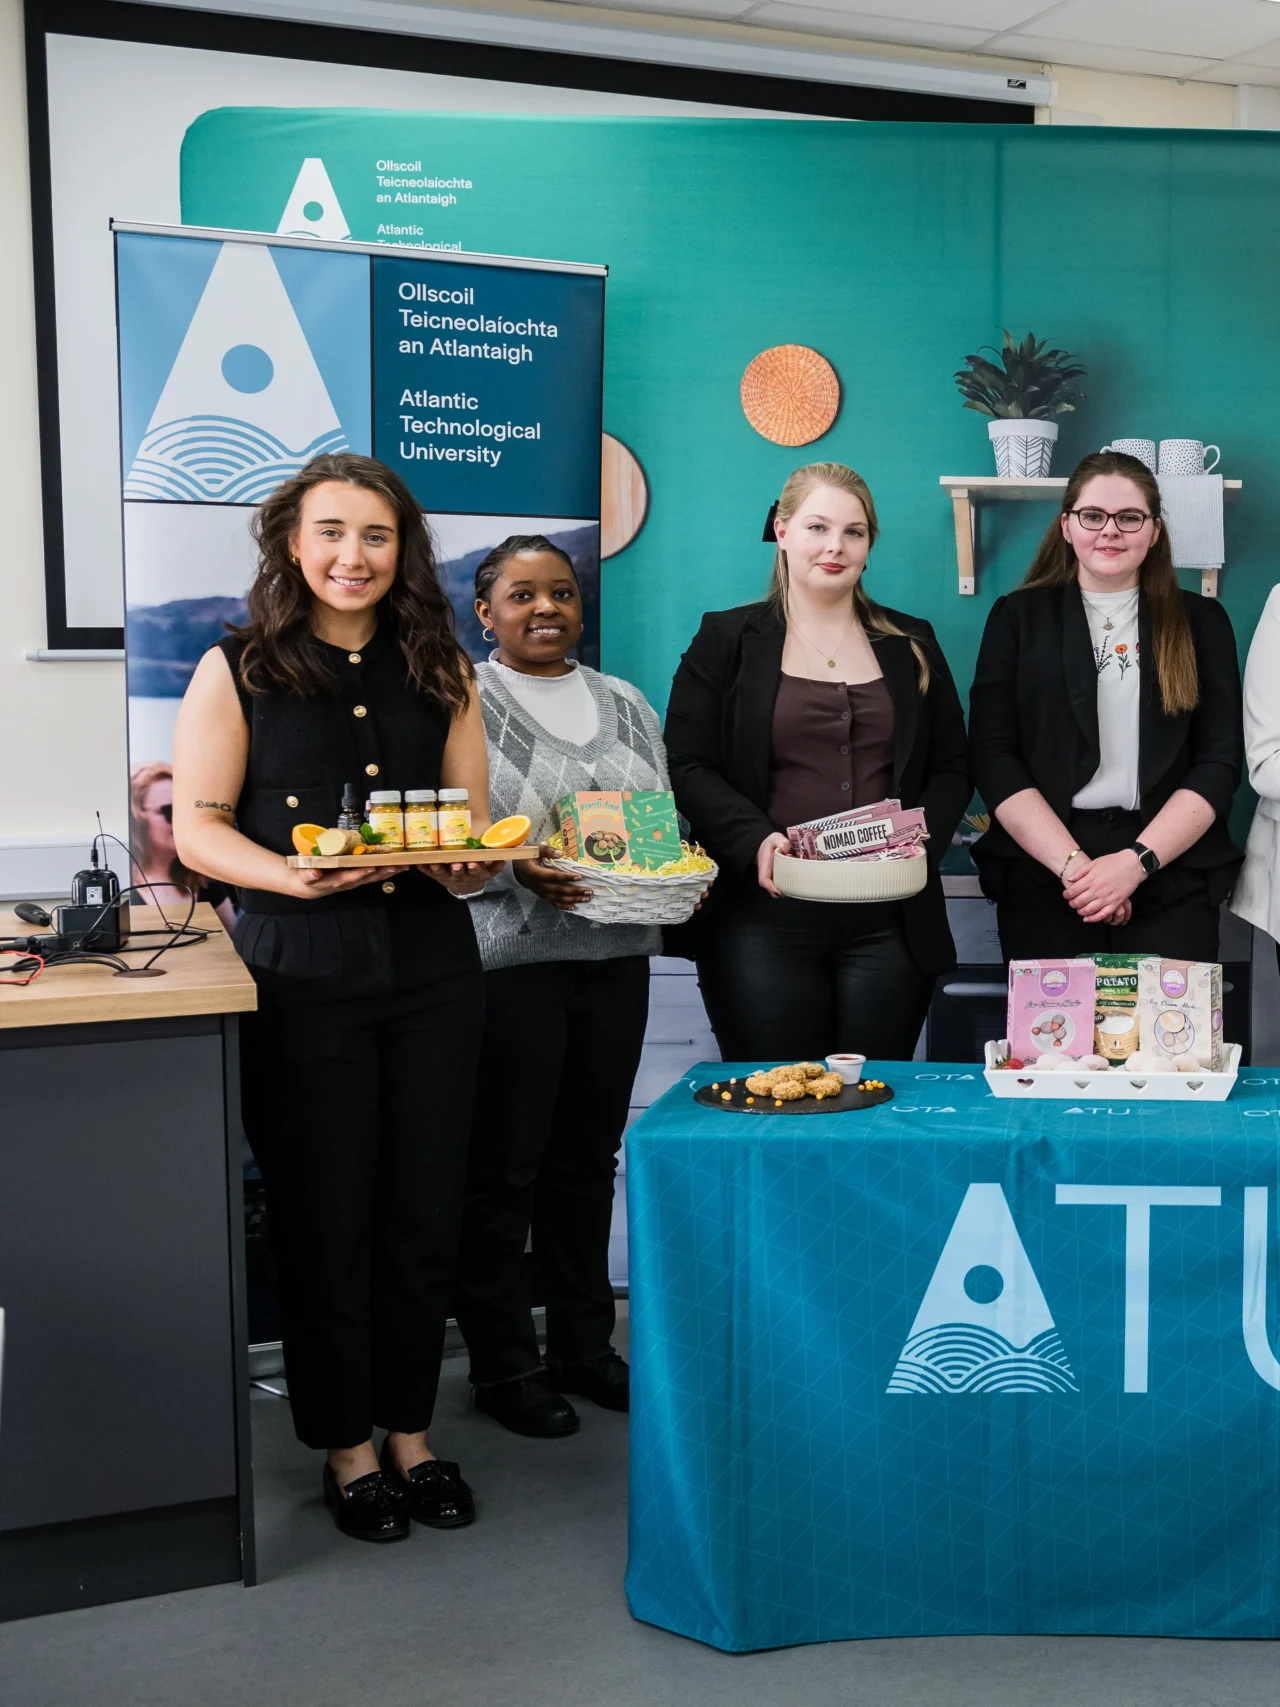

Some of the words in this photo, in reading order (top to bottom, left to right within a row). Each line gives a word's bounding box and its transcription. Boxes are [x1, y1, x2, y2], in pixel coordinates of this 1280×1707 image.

[376, 160, 421, 172] Ollscoil
[377, 177, 472, 189] Teicneolaíochta
[376, 193, 391, 203] an
[394, 192, 457, 207] Atlantaigh
[377, 224, 423, 236] Atlantic
[399, 283, 474, 306] Ollscoil
[399, 309, 558, 337] Teicneolaíochta
[399, 339, 424, 354] an
[430, 339, 532, 364] Atlantaigh
[400, 389, 478, 411] Atlantic
[400, 416, 541, 444] Technological
[400, 442, 501, 466] University
[823, 831, 855, 850] NOMAD
[857, 824, 886, 843] COFFEE
[1096, 977, 1137, 986] POTATO
[1063, 1107, 1131, 1115] ATU
